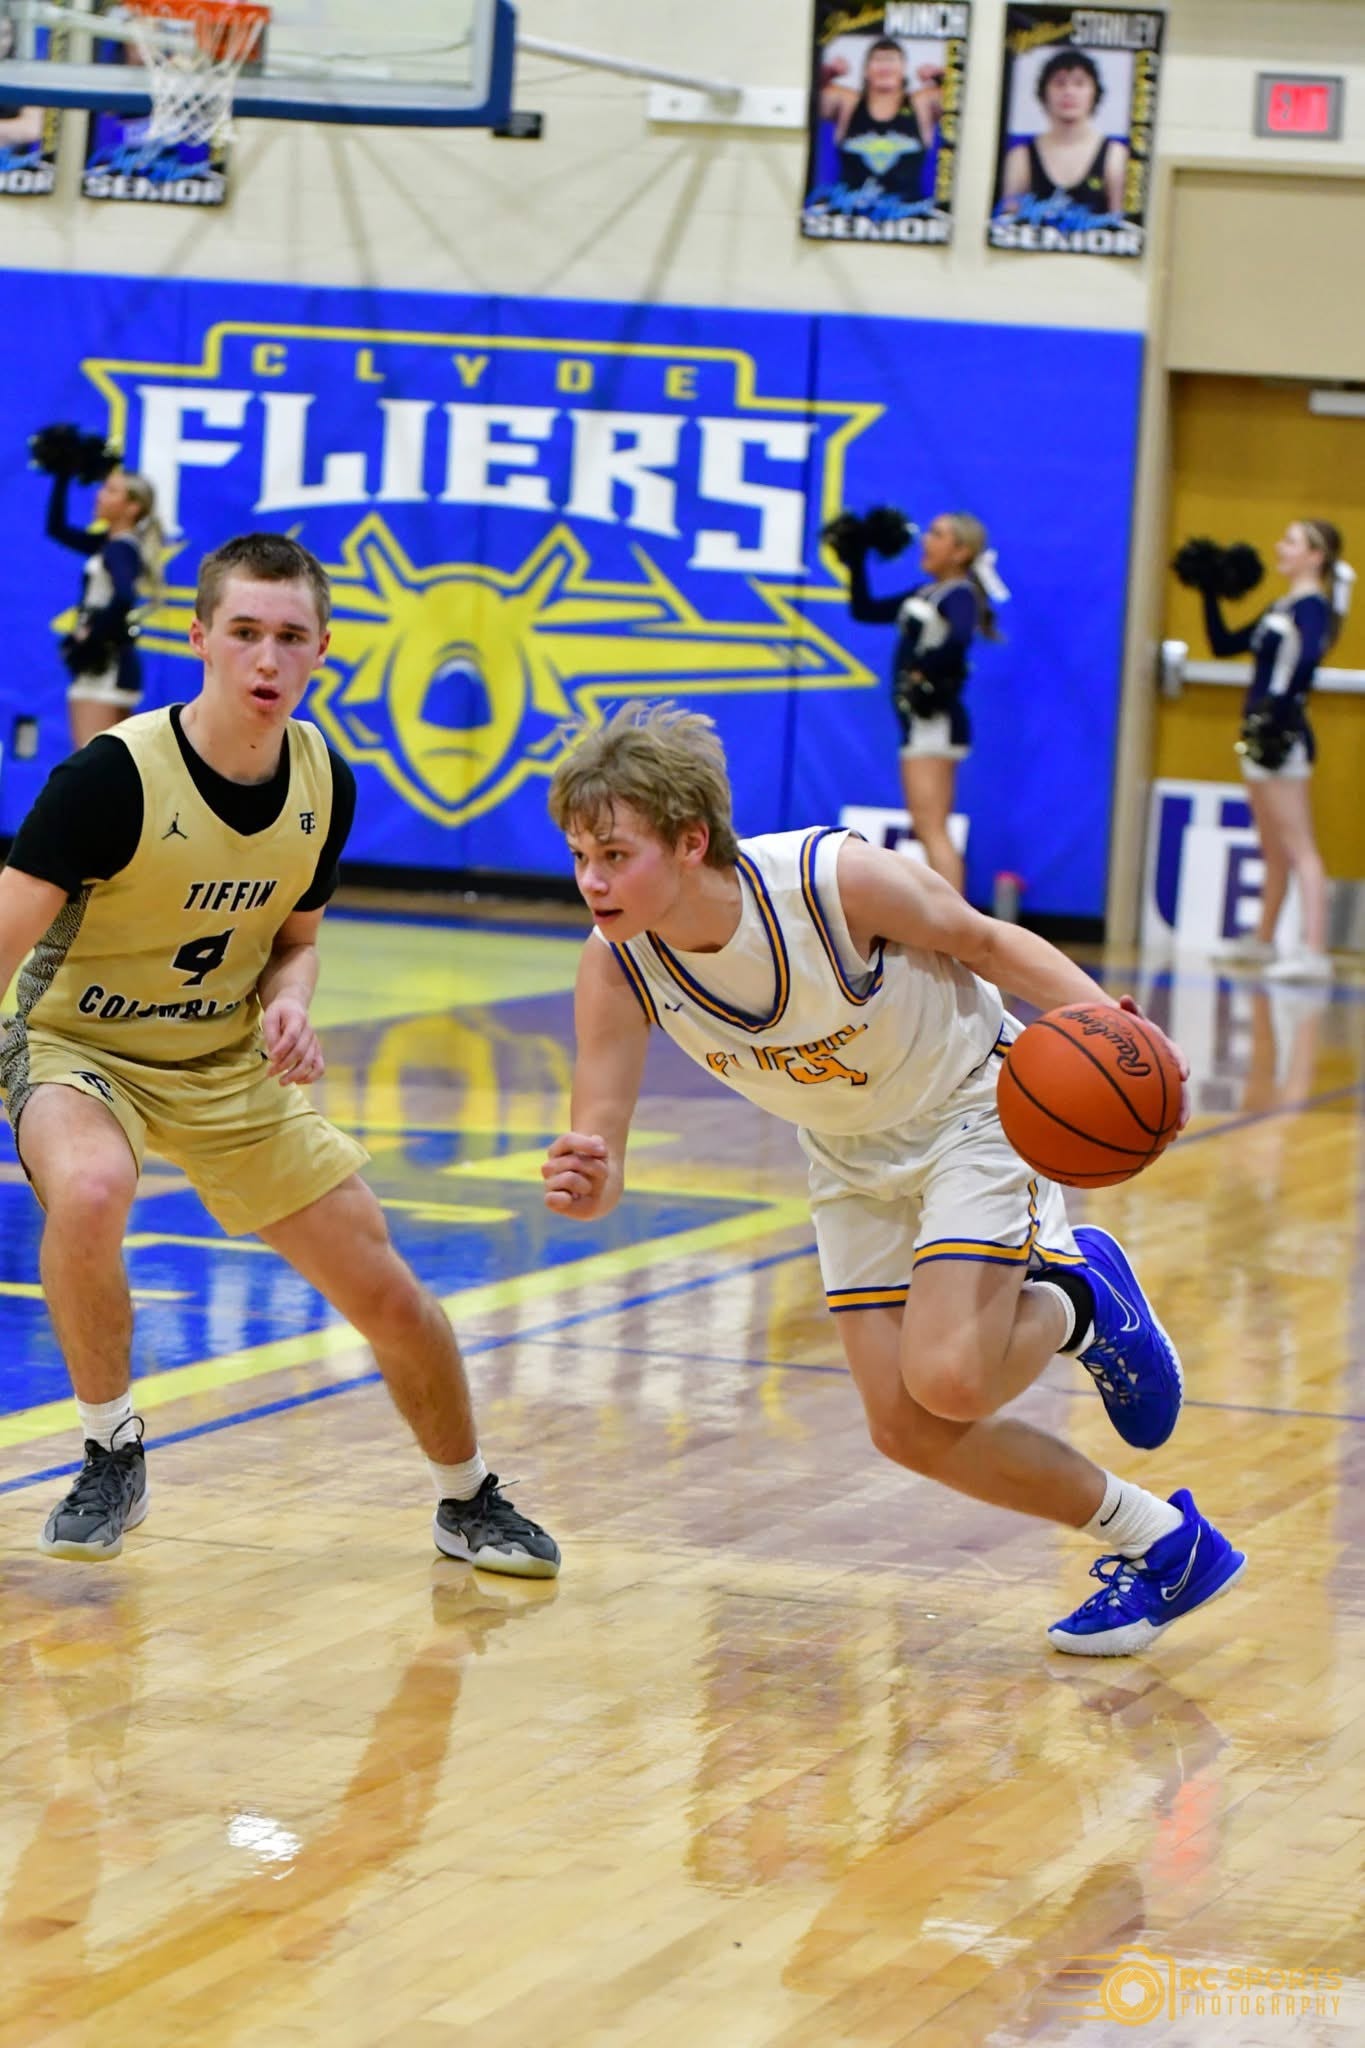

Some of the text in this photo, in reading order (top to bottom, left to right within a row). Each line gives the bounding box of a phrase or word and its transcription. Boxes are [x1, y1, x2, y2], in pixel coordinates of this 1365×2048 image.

[83, 174, 225, 205] SENIOR
[802, 213, 951, 243] SENIOR
[989, 223, 1142, 256] SENIOR
[252, 342, 698, 400] CLYDE
[135, 383, 819, 576] FLIERS
[182, 879, 278, 913] TIFFIN
